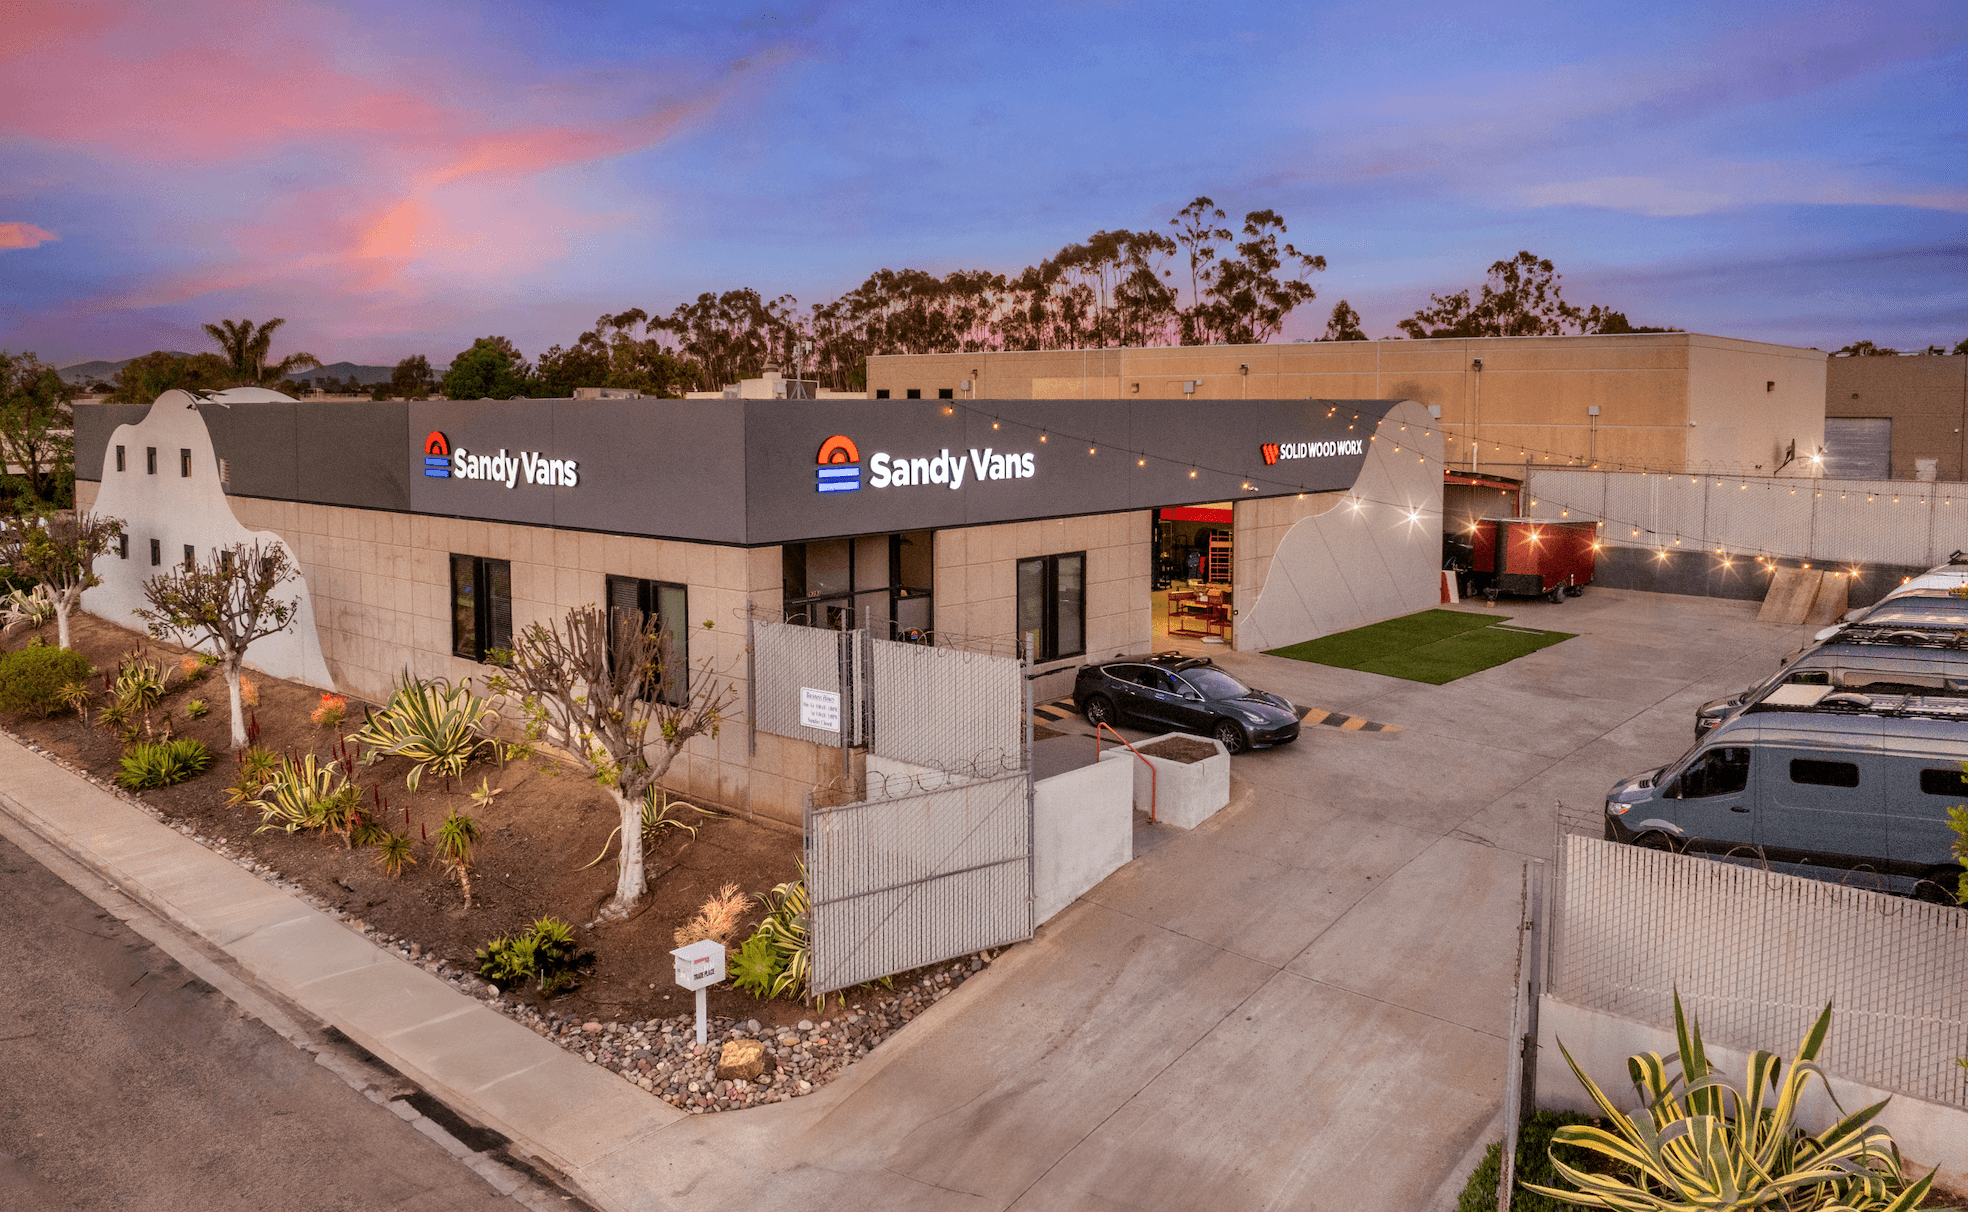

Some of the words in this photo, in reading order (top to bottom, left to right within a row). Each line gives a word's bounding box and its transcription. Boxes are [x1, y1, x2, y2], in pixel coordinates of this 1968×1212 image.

[454, 447, 519, 489] Sandy
[520, 451, 578, 487] Vans
[869, 448, 967, 490] Sandy
[969, 448, 1035, 481] Vans
[1280, 442, 1307, 460] SOLID
[1308, 441, 1336, 458] WOOD
[1336, 440, 1362, 456] WORX
